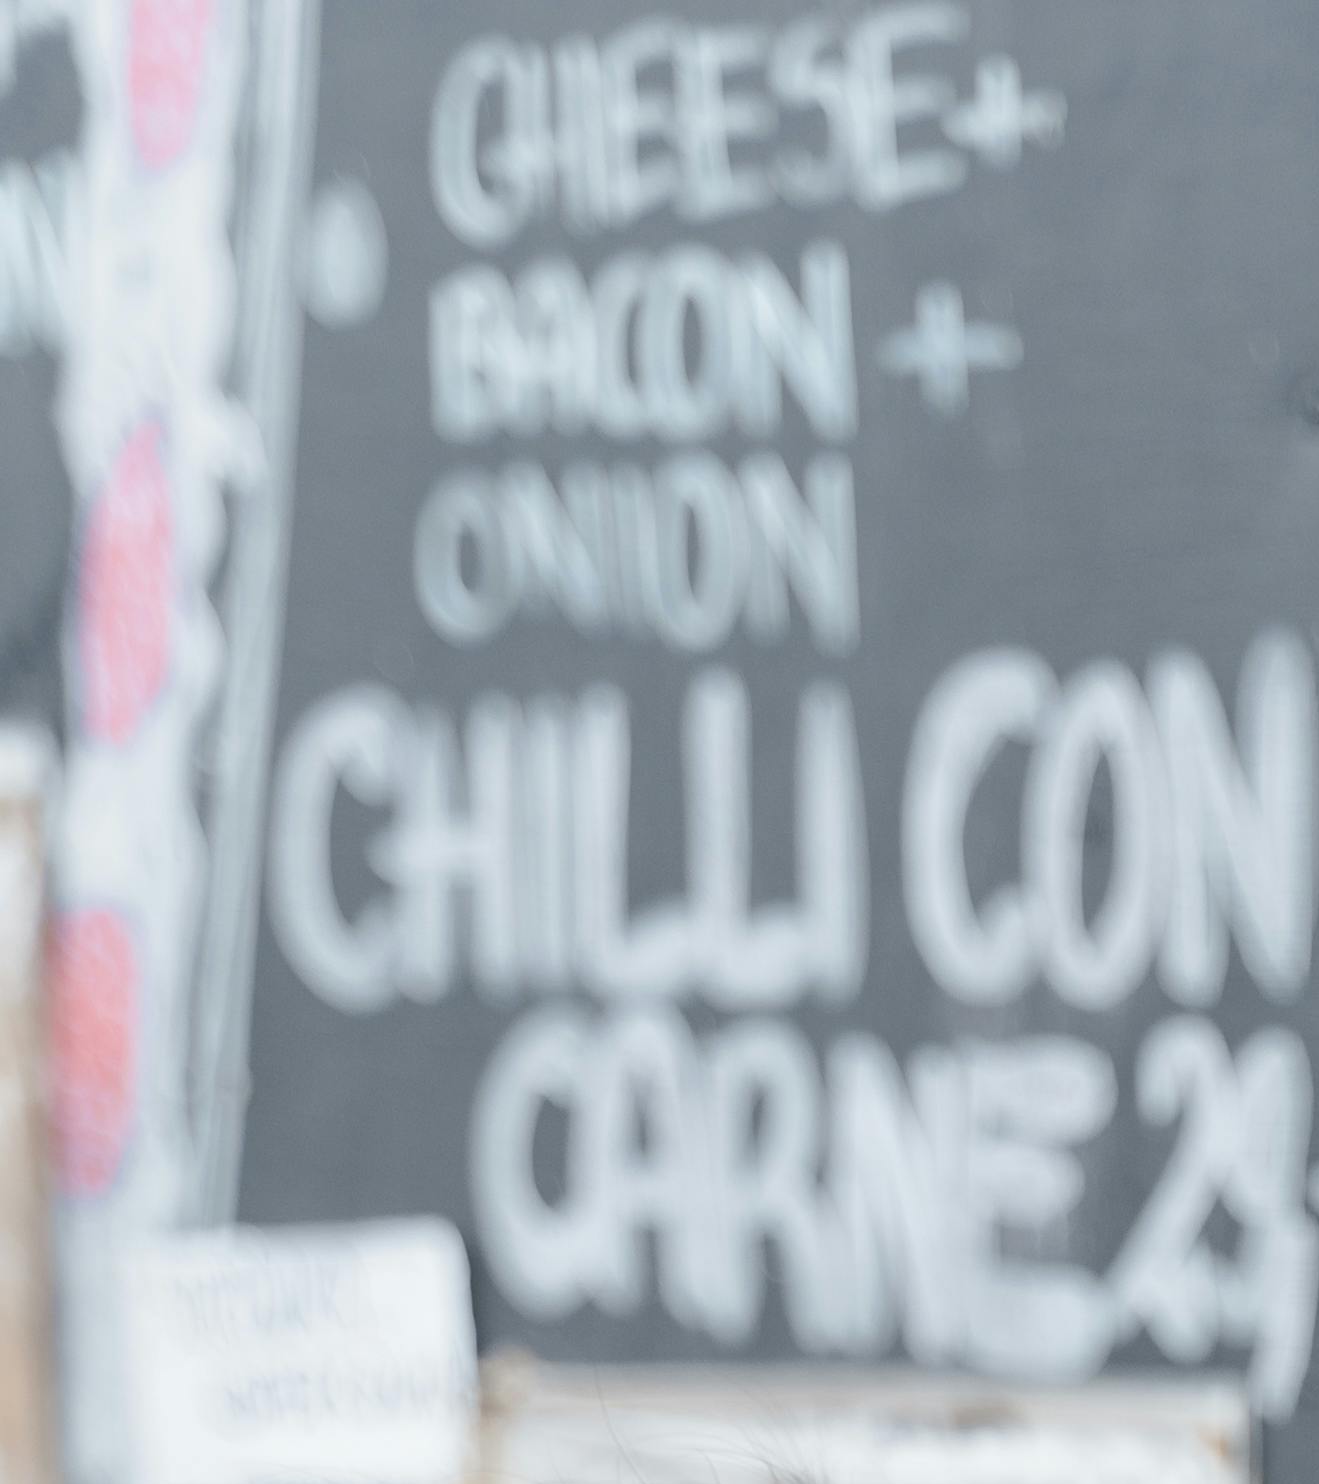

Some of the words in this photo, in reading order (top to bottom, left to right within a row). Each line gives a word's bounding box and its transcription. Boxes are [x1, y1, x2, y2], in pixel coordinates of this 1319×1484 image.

[428, 240, 860, 442] BACON
[412, 450, 860, 655] ONION
[268, 668, 872, 1010] CHILLI
[470, 1003, 1116, 1380] CARNE
